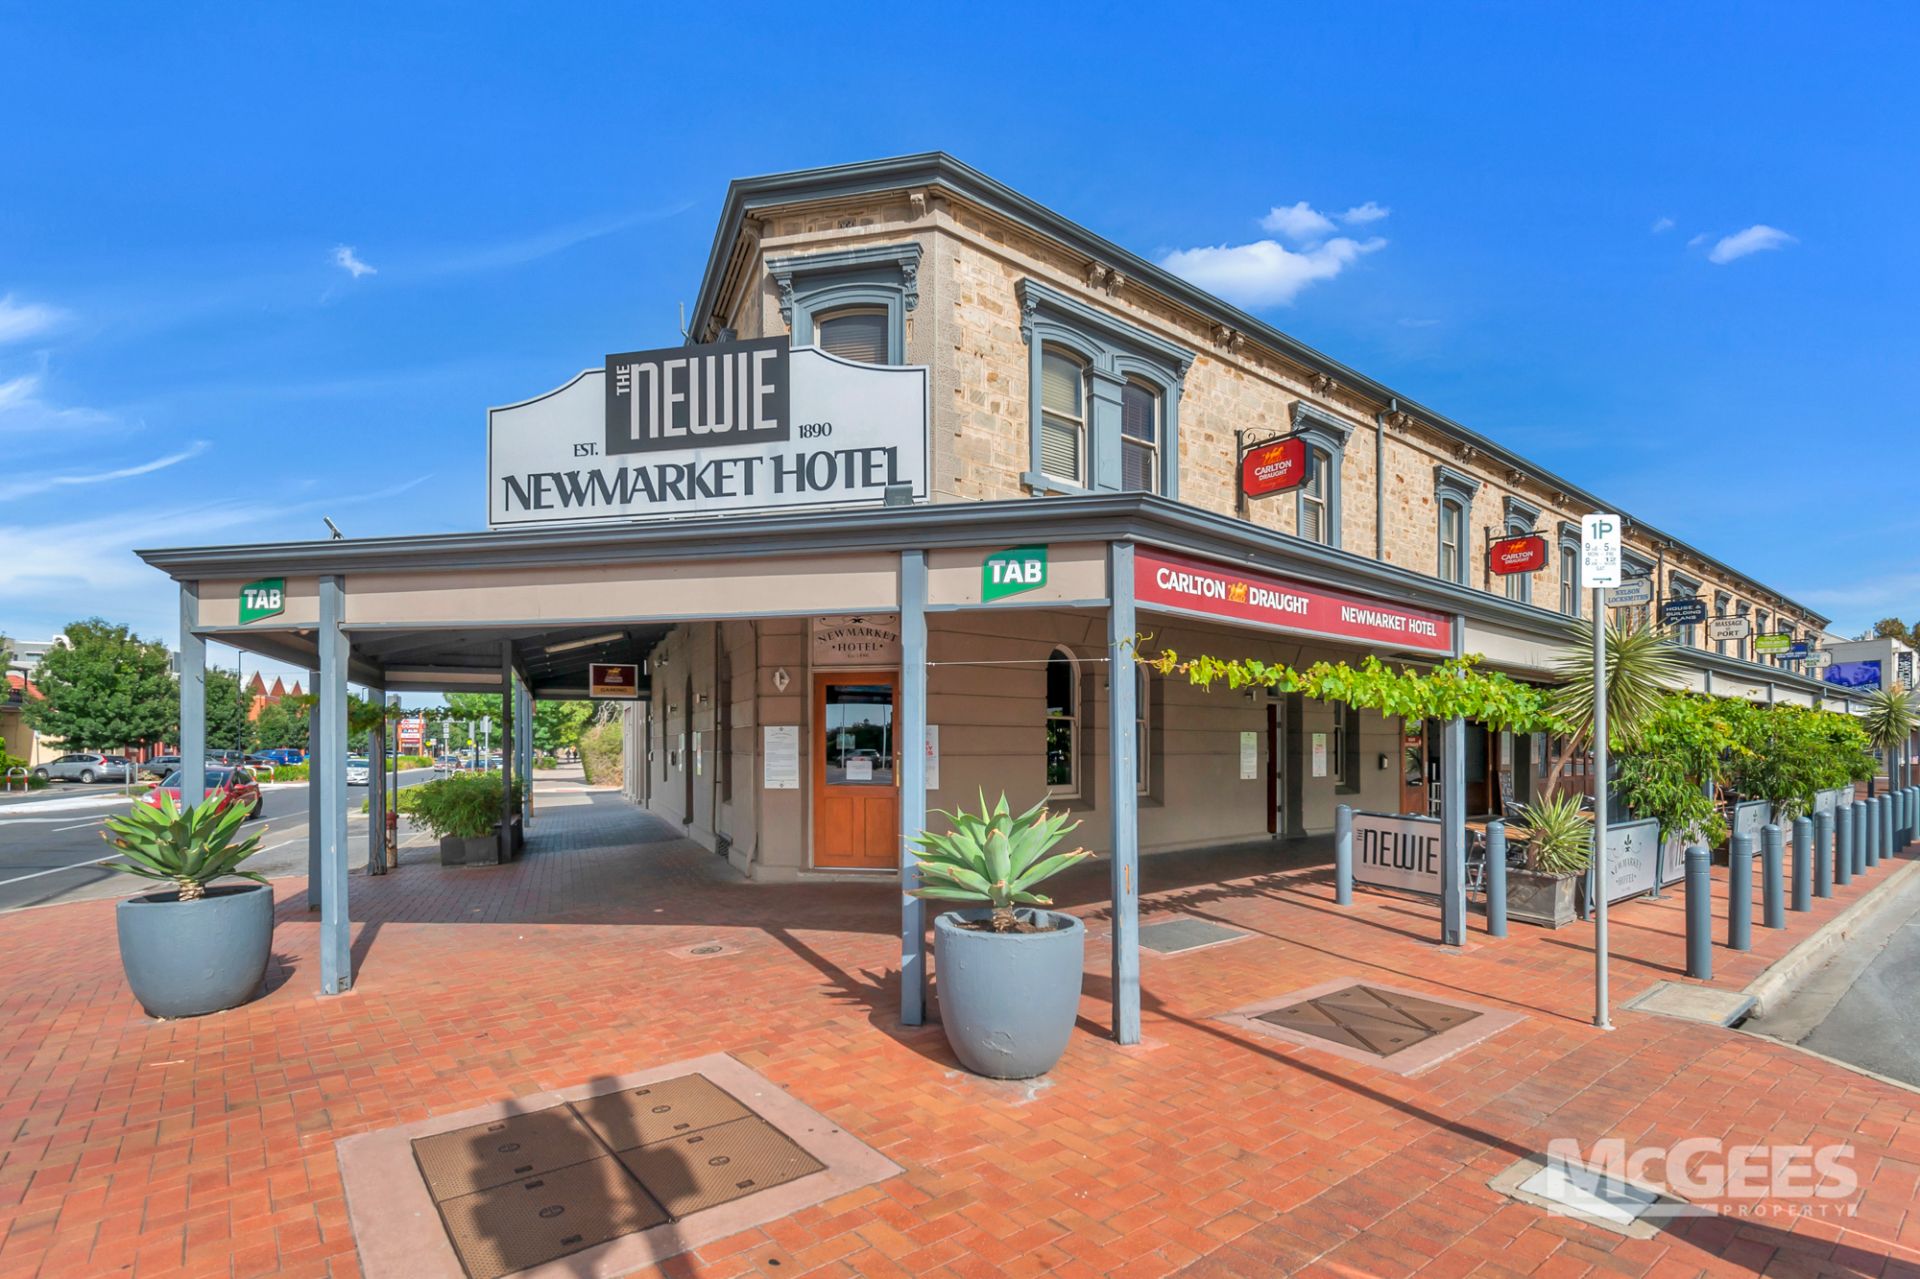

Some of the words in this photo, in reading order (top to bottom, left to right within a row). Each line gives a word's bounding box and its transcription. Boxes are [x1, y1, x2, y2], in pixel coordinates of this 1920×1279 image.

[616, 364, 631, 396] THE
[630, 349, 778, 441] NEWIE
[798, 422, 833, 440] 1890
[573, 442, 599, 458] EST.
[1254, 460, 1292, 476] CARLTON
[1258, 469, 1287, 481] DRAUGHT
[502, 456, 763, 512] NEWMARKET
[770, 446, 913, 494] HOTEL
[1591, 522, 1613, 540] 1P
[1501, 551, 1533, 561] CARLTON
[988, 560, 1042, 584] TAB
[244, 589, 281, 609] TAB
[1156, 567, 1226, 600] CARLTON
[1249, 587, 1309, 615] DRAUGHT
[1341, 606, 1406, 631] NEWMARKET
[1408, 618, 1437, 637] HOTEL
[818, 627, 897, 644] NEWMARKET
[838, 642, 878, 652] HOTEL
[1363, 829, 1439, 875] NEWIE
